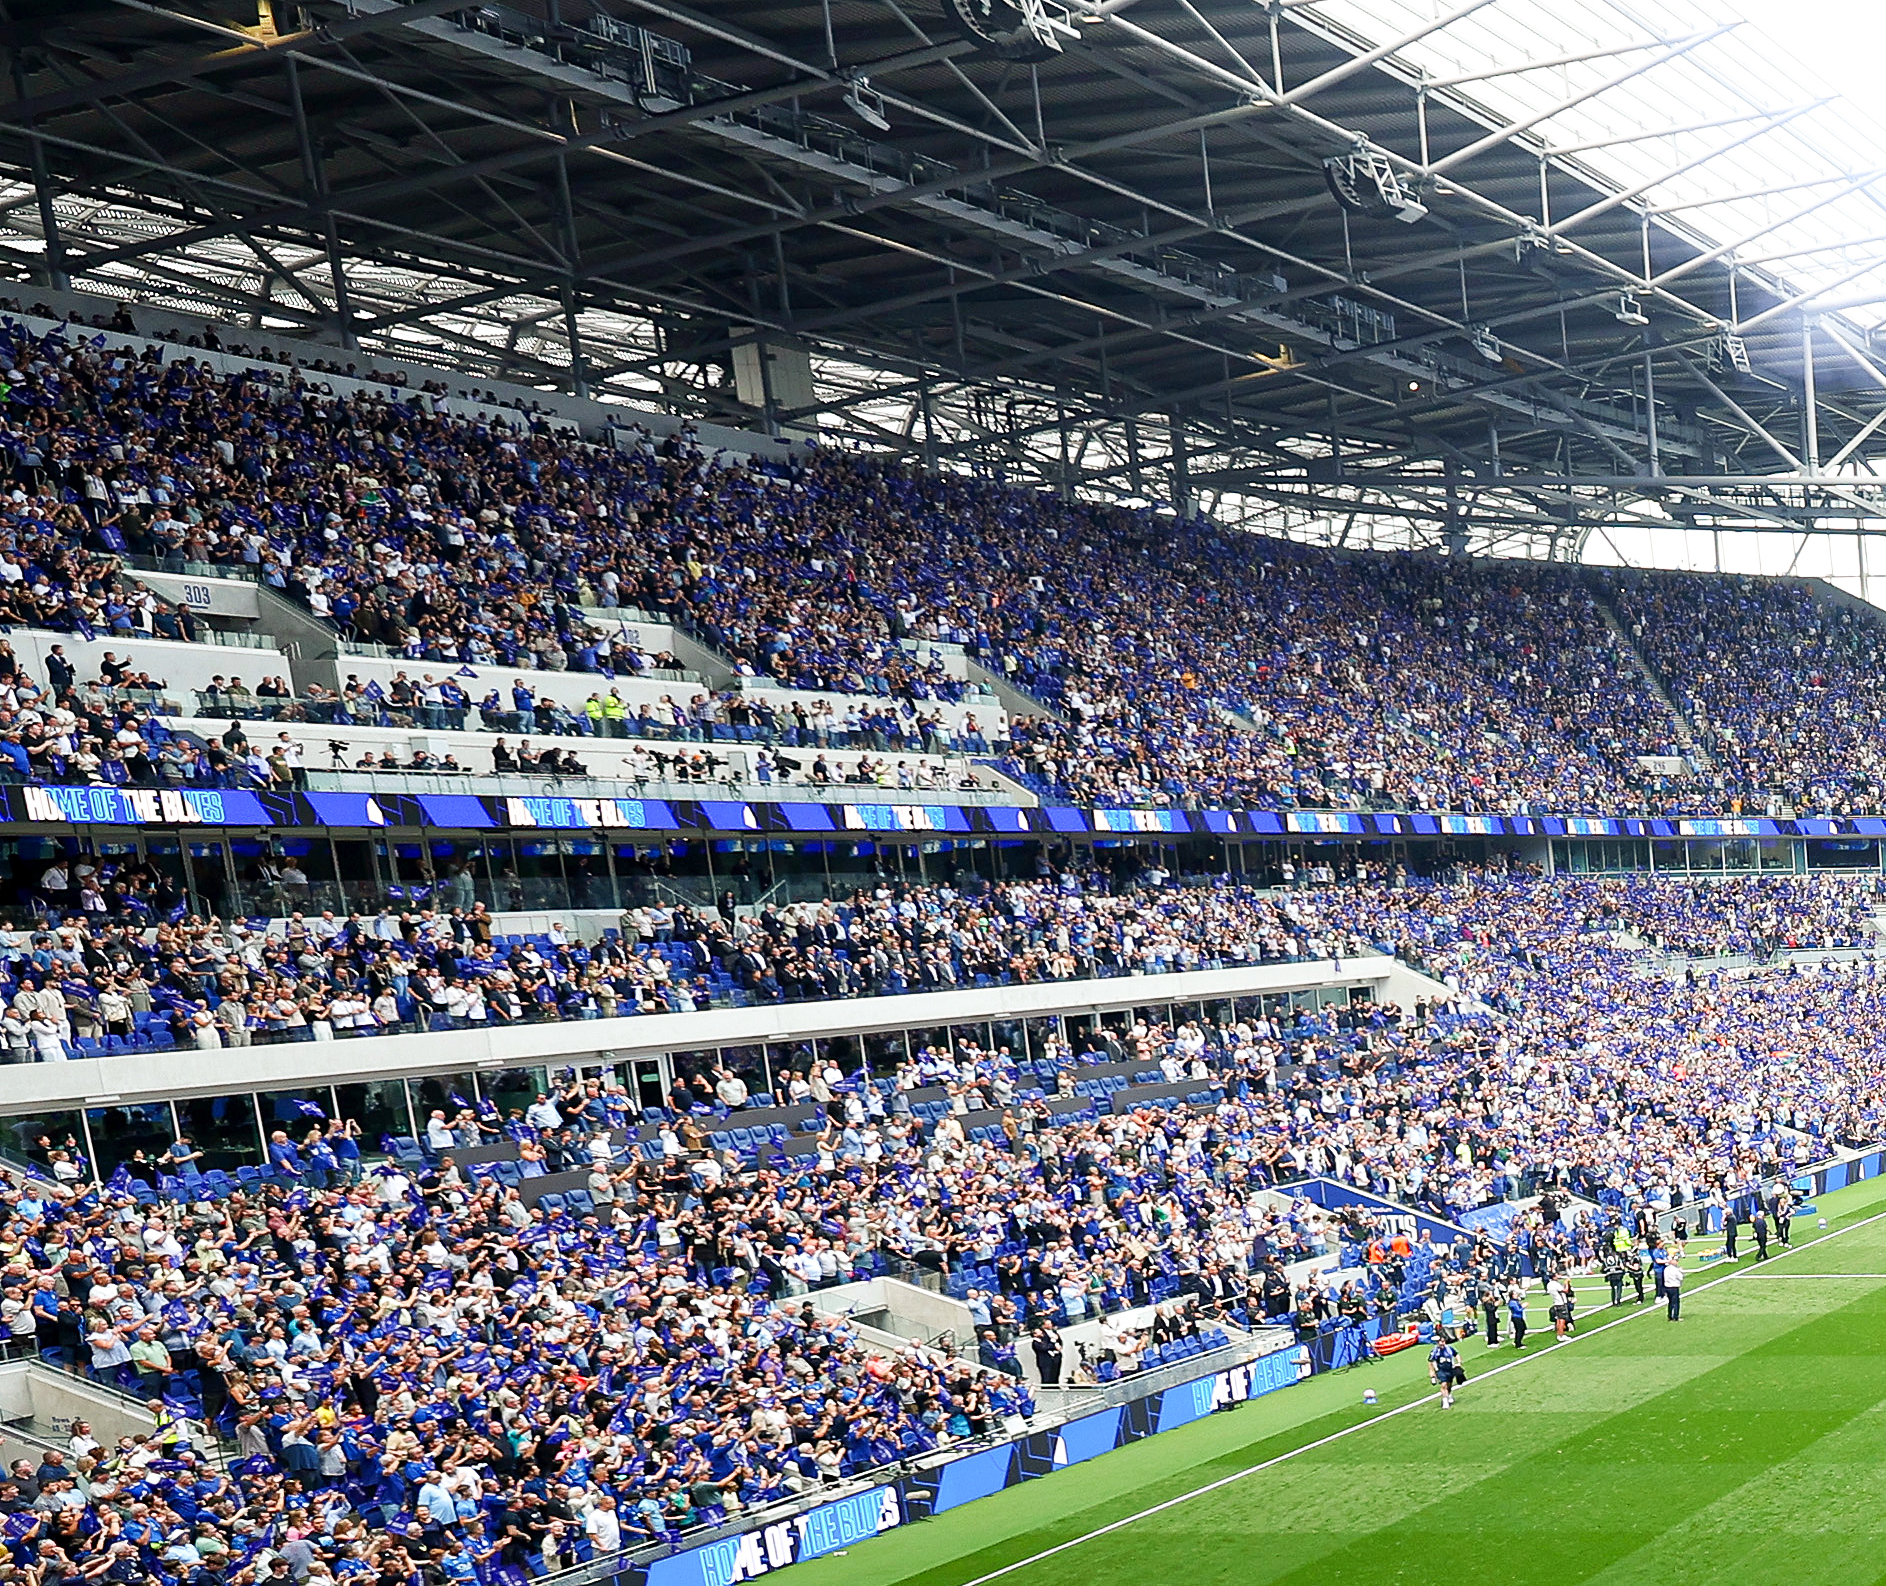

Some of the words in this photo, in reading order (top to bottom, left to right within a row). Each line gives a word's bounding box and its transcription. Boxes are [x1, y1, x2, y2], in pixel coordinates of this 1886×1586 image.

[23, 786, 90, 821] HOME
[88, 789, 121, 822] OF
[119, 789, 163, 823] THE
[160, 790, 225, 823] BLUES
[765, 1520, 794, 1568] OF
[794, 1506, 840, 1557] THE
[836, 1485, 901, 1544] BLUES
